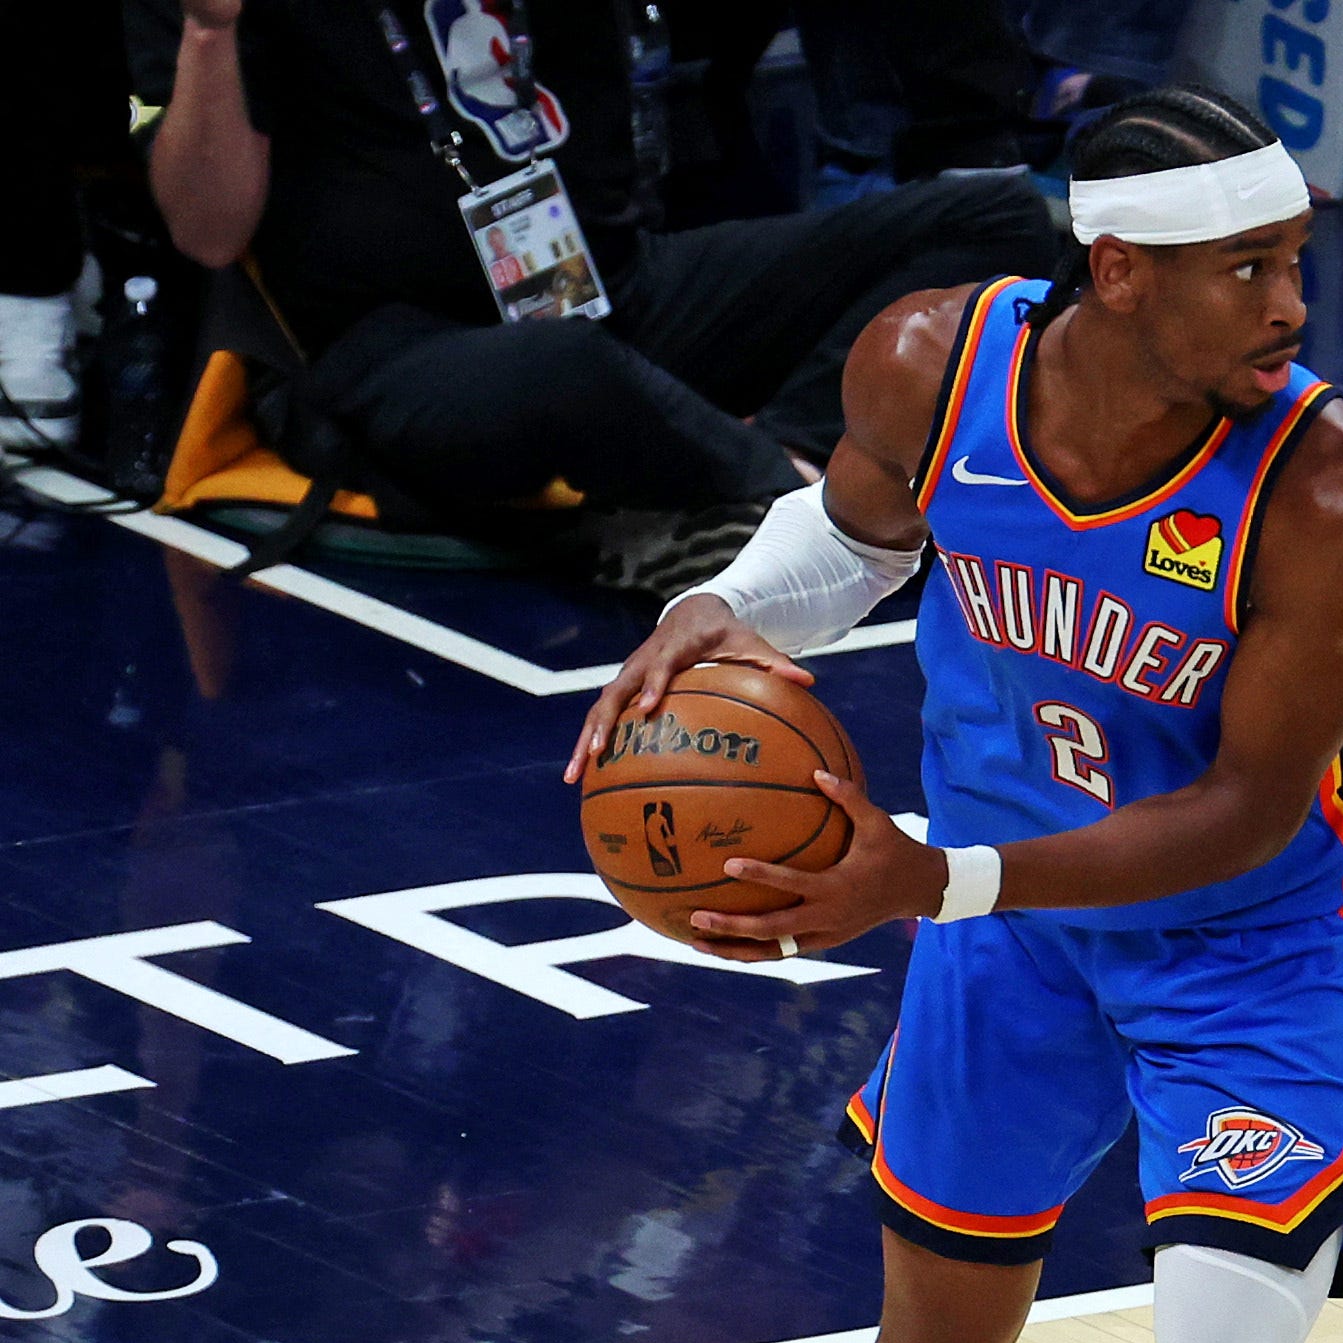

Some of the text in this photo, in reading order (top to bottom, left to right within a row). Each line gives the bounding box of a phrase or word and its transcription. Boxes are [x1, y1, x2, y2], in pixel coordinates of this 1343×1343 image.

[933, 541, 1229, 708] THUNDER
[597, 712, 761, 770] Wilson
[1032, 700, 1115, 810] 2
[0, 873, 882, 1109] TR
[1195, 1129, 1279, 1165] OKC
